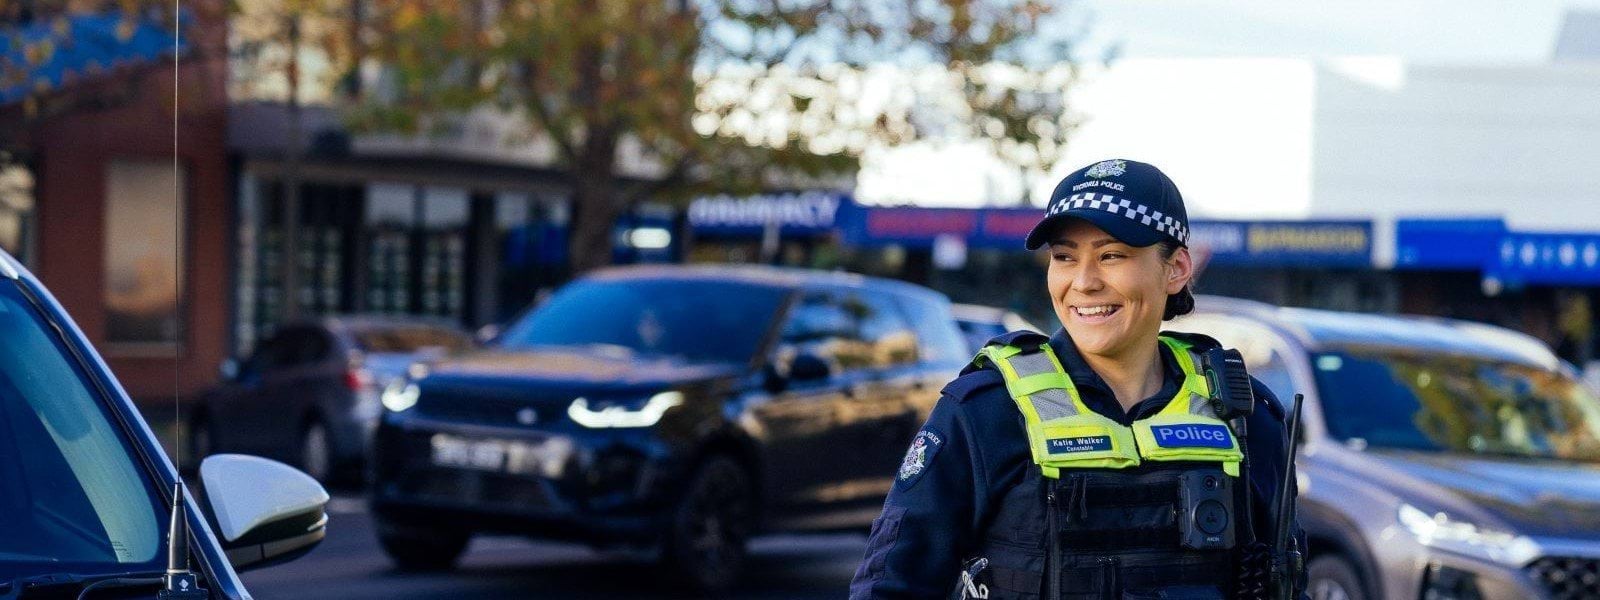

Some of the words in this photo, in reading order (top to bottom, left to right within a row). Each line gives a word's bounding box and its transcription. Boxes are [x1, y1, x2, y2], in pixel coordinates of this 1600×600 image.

[1073, 180, 1099, 191] VICTORIA
[1101, 180, 1125, 192] POLICE
[1159, 427, 1225, 441] Police
[1052, 439, 1073, 447] Katie
[1076, 437, 1104, 446] Walker
[1066, 445, 1094, 453] Constable
